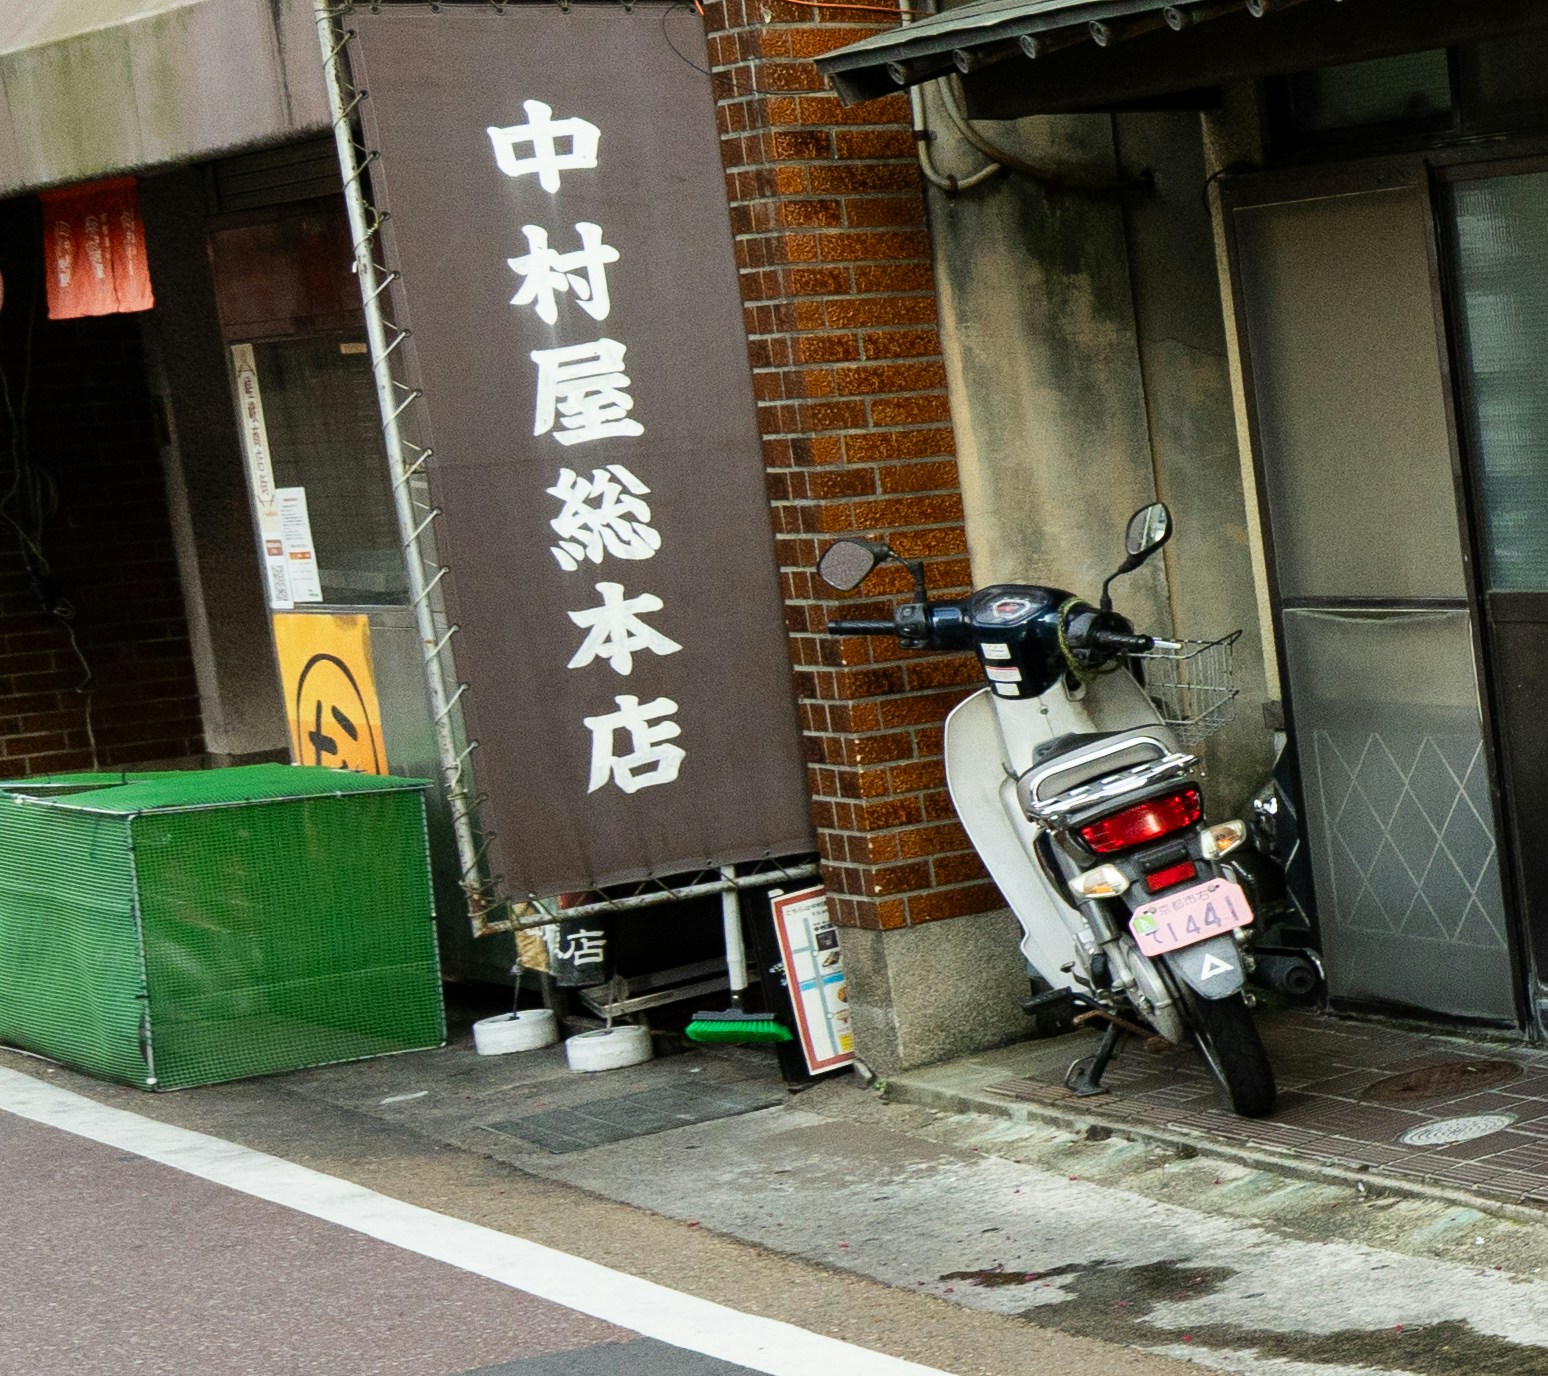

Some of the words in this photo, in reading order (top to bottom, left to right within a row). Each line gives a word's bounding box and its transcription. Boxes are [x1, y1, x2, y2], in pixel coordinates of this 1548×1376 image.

[487, 99, 685, 795] 中村屋総本店
